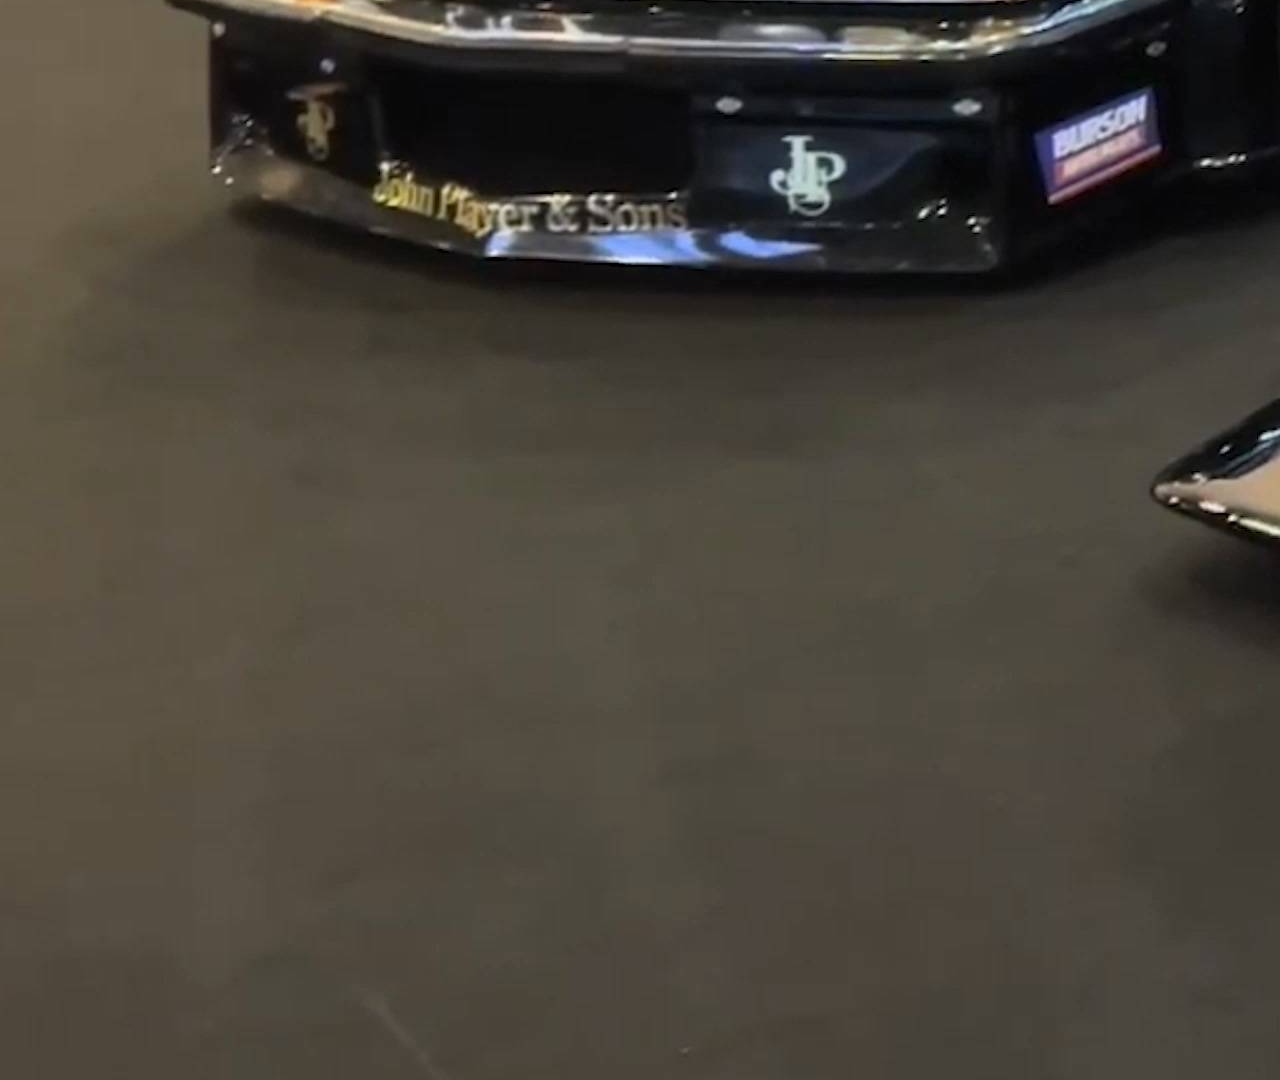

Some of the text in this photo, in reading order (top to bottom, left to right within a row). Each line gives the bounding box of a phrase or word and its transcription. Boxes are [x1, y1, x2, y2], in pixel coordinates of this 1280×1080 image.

[436, 182, 539, 239] Player
[545, 193, 582, 233] &
[586, 192, 689, 234] Sons
